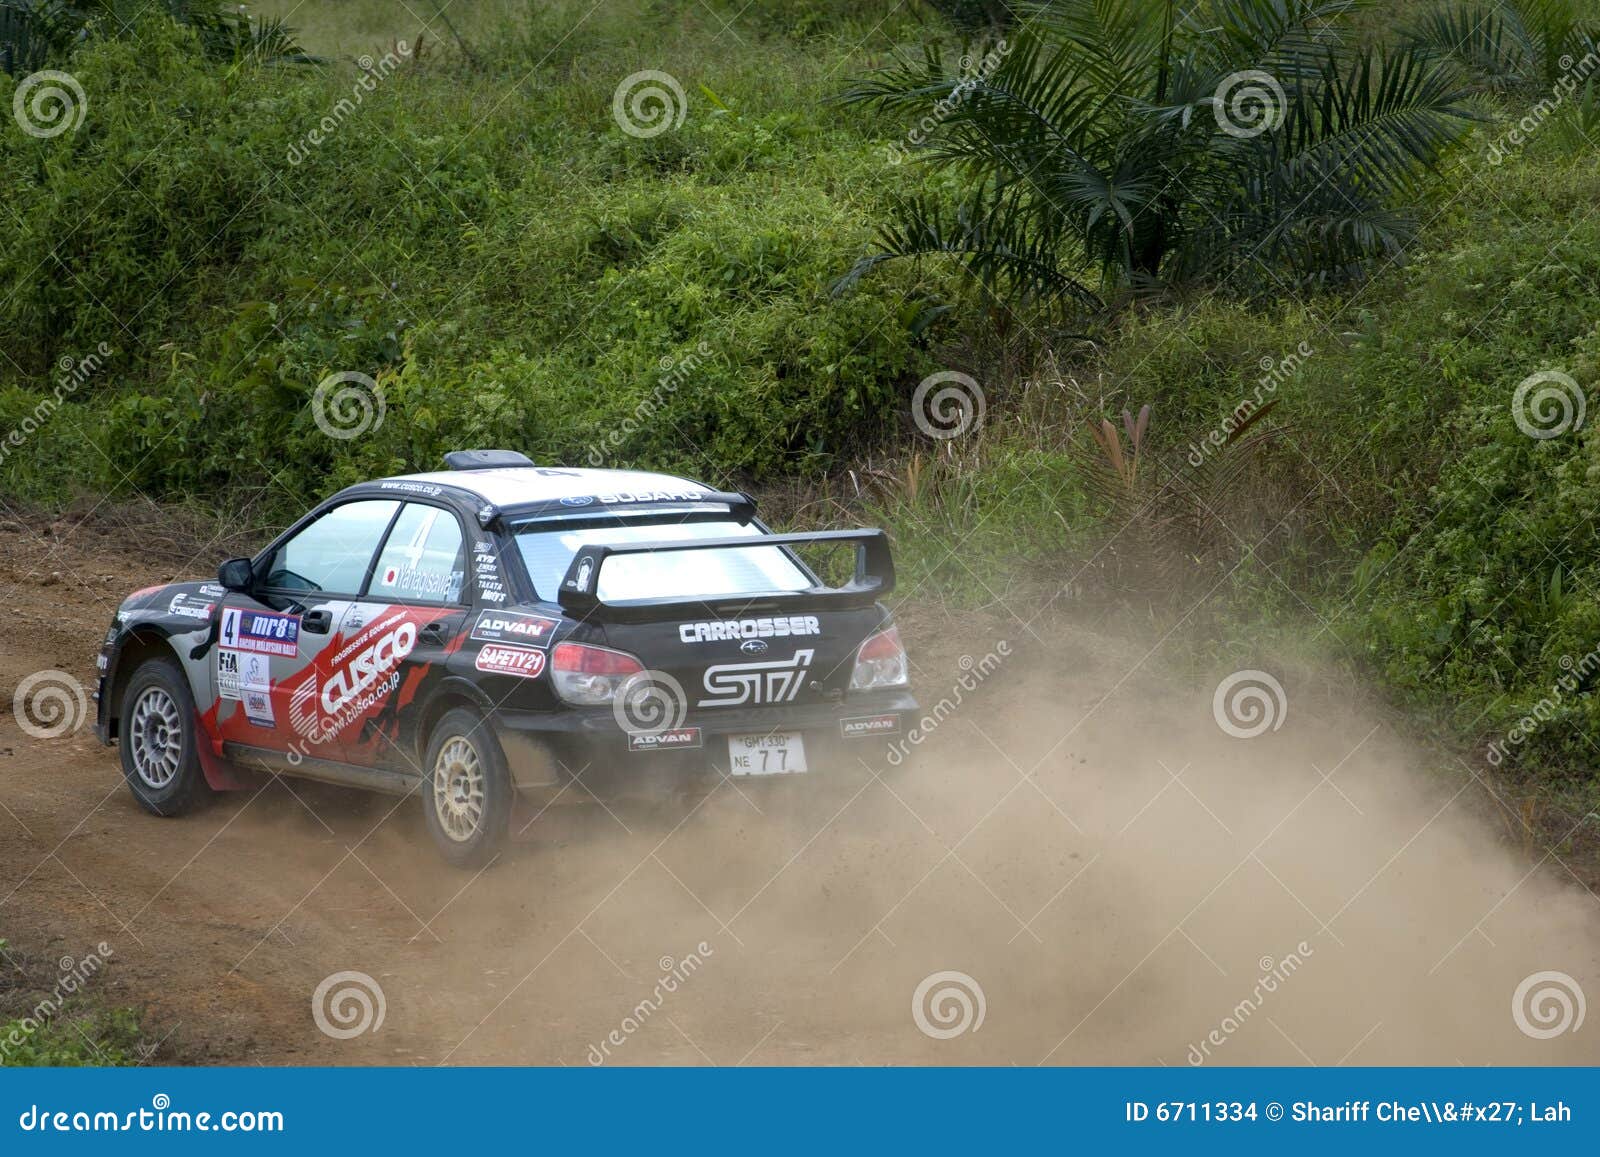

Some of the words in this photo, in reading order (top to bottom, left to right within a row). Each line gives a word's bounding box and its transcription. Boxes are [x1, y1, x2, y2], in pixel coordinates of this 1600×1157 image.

[478, 580, 503, 590] TAKATA
[224, 611, 235, 645] 4
[478, 618, 544, 636] ADVAN
[679, 616, 821, 643] CARROSSER
[321, 622, 417, 715] CUSCO
[845, 720, 894, 732] ADVAN
[633, 733, 691, 745] ADVAN
[734, 756, 750, 768] NE
